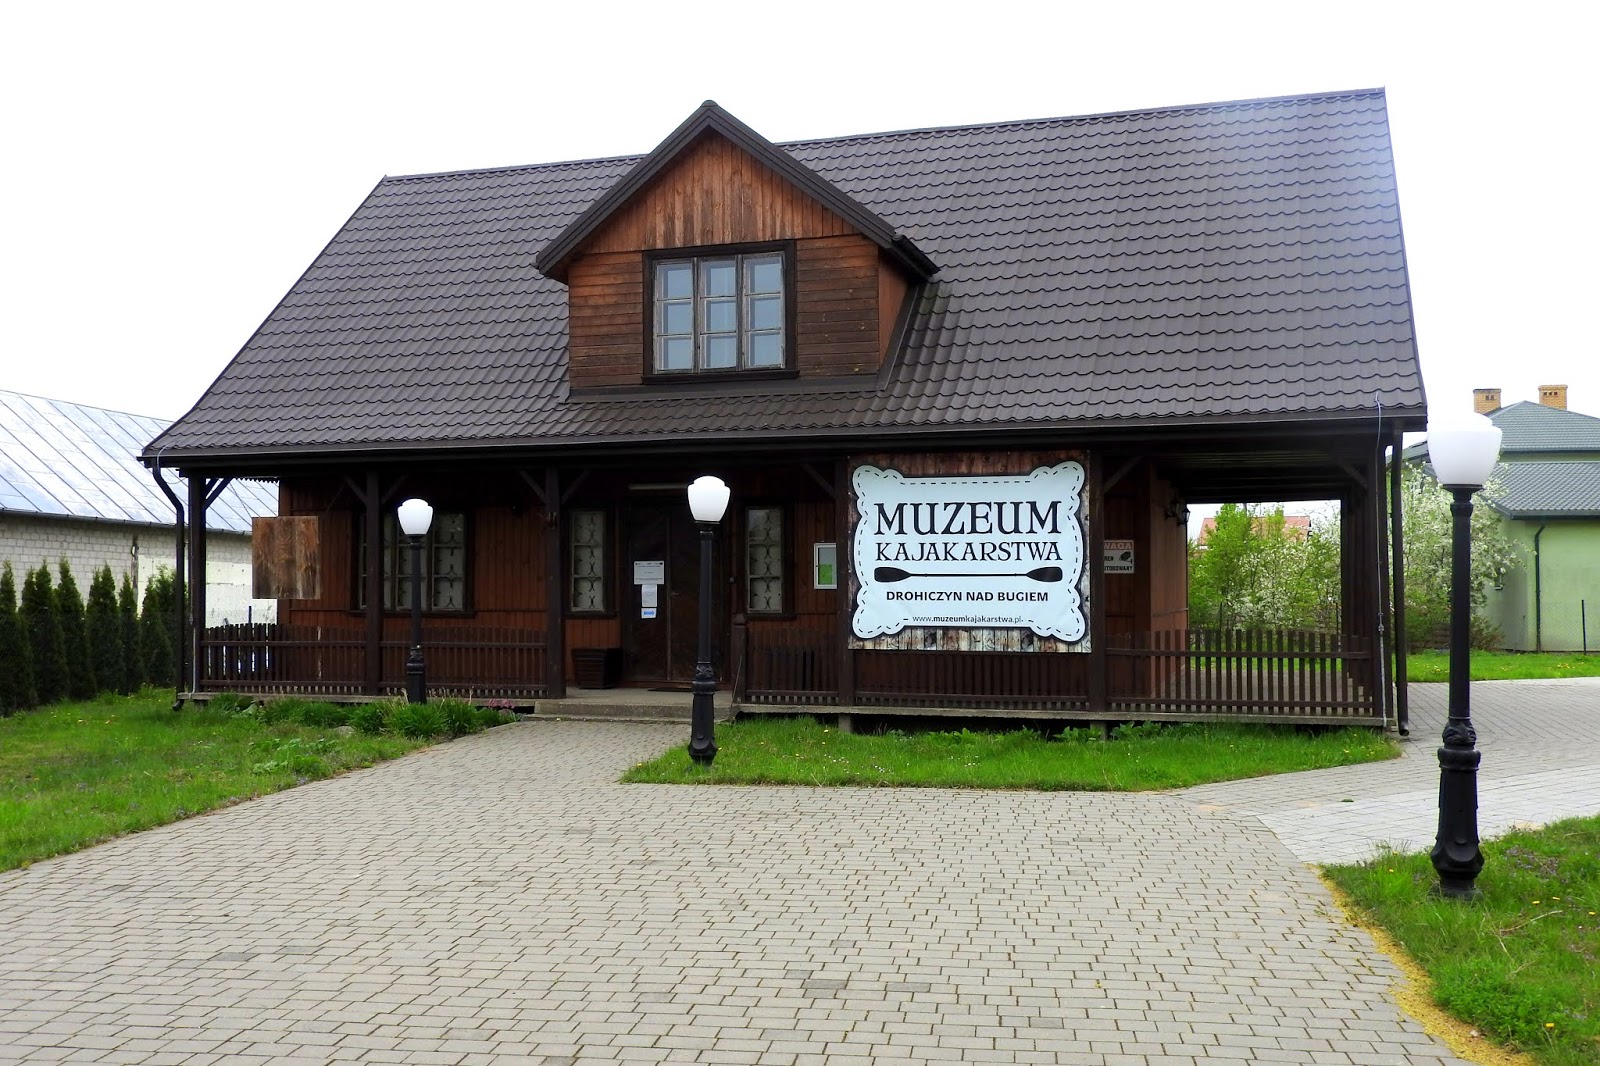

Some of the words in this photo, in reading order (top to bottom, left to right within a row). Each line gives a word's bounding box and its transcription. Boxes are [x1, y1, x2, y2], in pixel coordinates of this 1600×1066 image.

[873, 500, 1062, 536] MUZEUM
[875, 541, 1063, 562] KAJAKARSTWA
[886, 591, 962, 601] DROHICZYN
[966, 591, 994, 602] NAD
[997, 592, 1049, 602] BUGIEM
[912, 615, 1022, 624] www.muzeumkajakarstwa.pl
